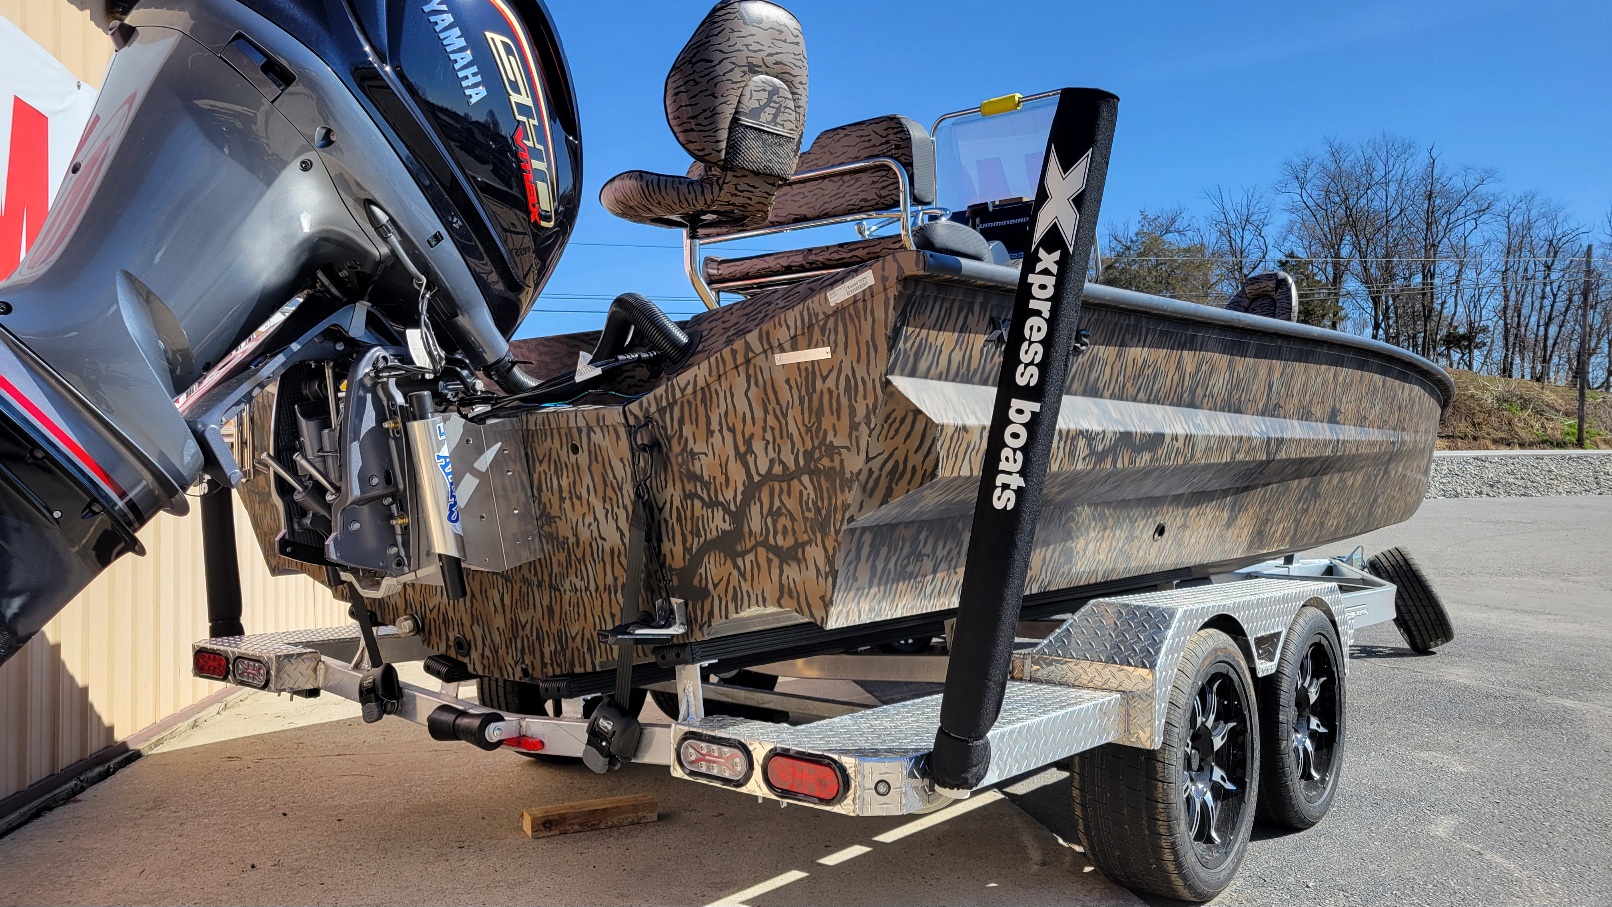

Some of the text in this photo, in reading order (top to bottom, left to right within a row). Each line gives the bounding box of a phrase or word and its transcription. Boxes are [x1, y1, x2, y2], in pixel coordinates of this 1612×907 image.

[421, 0, 488, 106] YAMAHA
[484, 31, 555, 228] SHO
[1015, 247, 1062, 387] xpress
[992, 397, 1040, 511] boats
